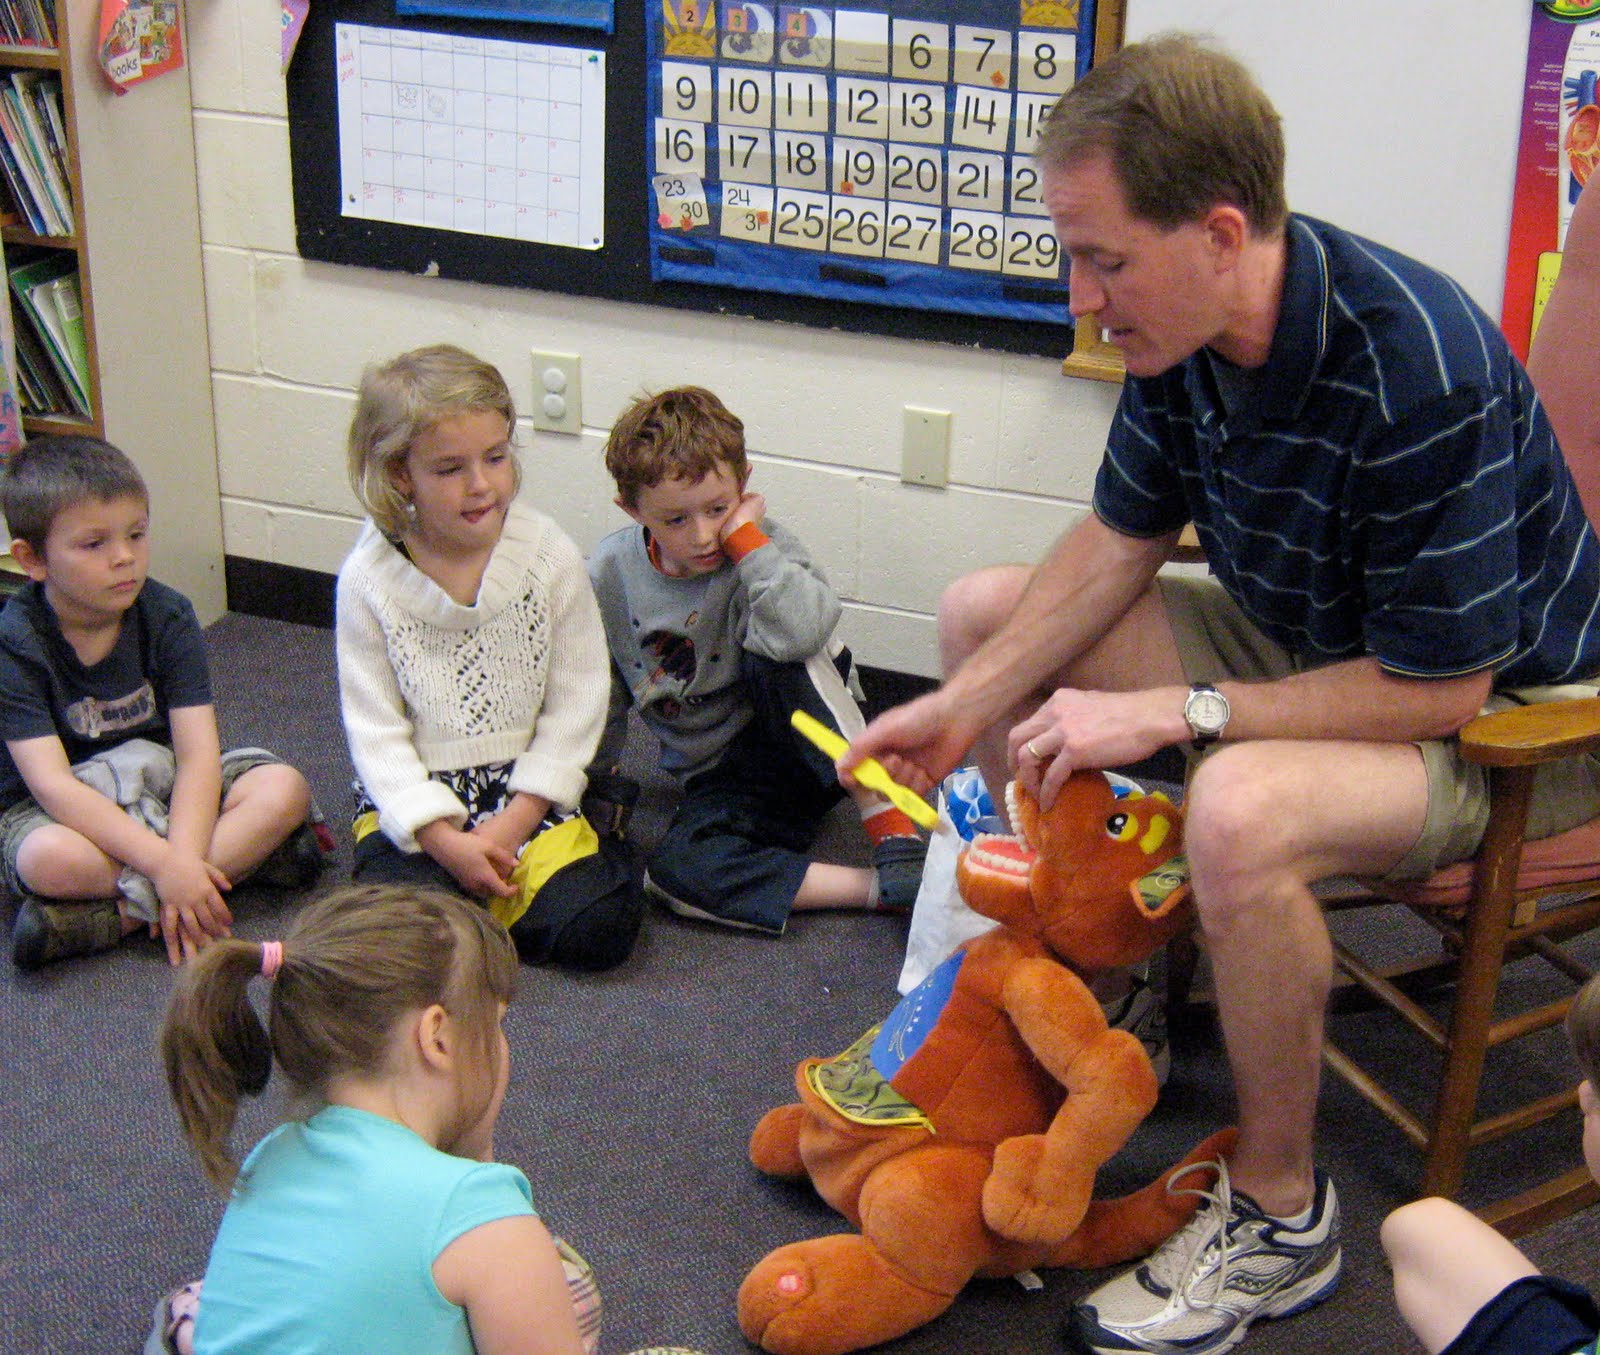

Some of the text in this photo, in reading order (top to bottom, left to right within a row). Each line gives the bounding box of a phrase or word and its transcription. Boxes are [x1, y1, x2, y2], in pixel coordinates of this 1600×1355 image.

[686, 10, 695, 22] 2
[909, 33, 932, 70] 6
[972, 36, 996, 73] 7
[1033, 42, 1057, 80] 8
[675, 75, 697, 111] 9
[729, 77, 760, 115] 10
[787, 82, 814, 118] 11
[847, 87, 879, 125] 12
[901, 92, 933, 129] 13
[962, 95, 997, 135] 14
[661, 179, 686, 197] 23
[665, 127, 1044, 203] 16 17 18 19 20 21 2
[680, 200, 703, 220] 30
[727, 188, 751, 206] 24
[778, 200, 1059, 270] 25 26 27 28 29
